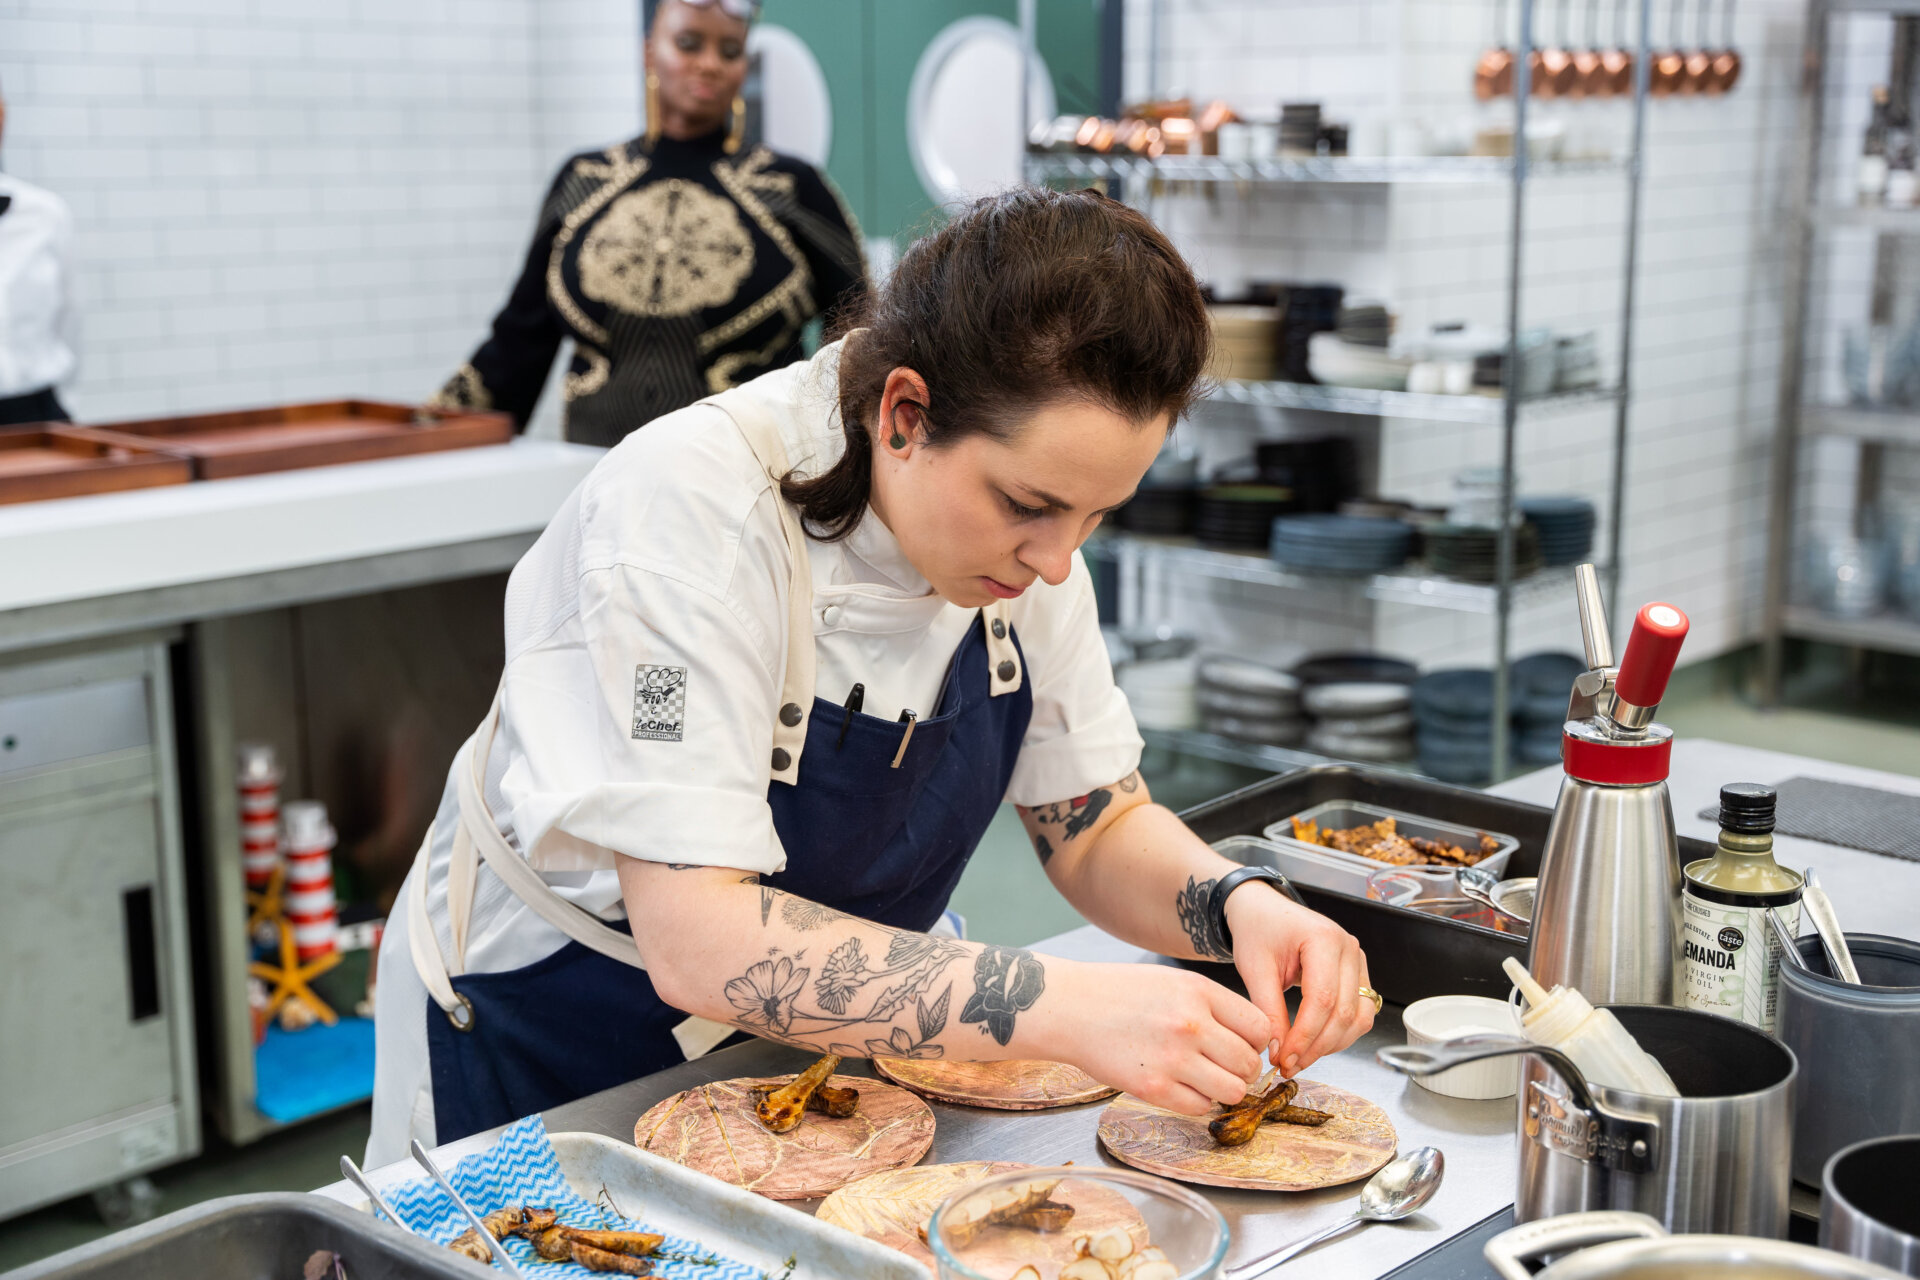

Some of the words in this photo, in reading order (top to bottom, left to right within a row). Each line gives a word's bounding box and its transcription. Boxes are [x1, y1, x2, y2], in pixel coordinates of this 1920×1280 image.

[634, 731, 680, 740] PROFESSIONAL
[1693, 926, 1711, 941] ESTATE
[1719, 933, 1742, 946] taste
[1685, 940, 1736, 970] EMANDA
[1690, 967, 1725, 983] VIRGIN
[1697, 978, 1712, 989] OIL
